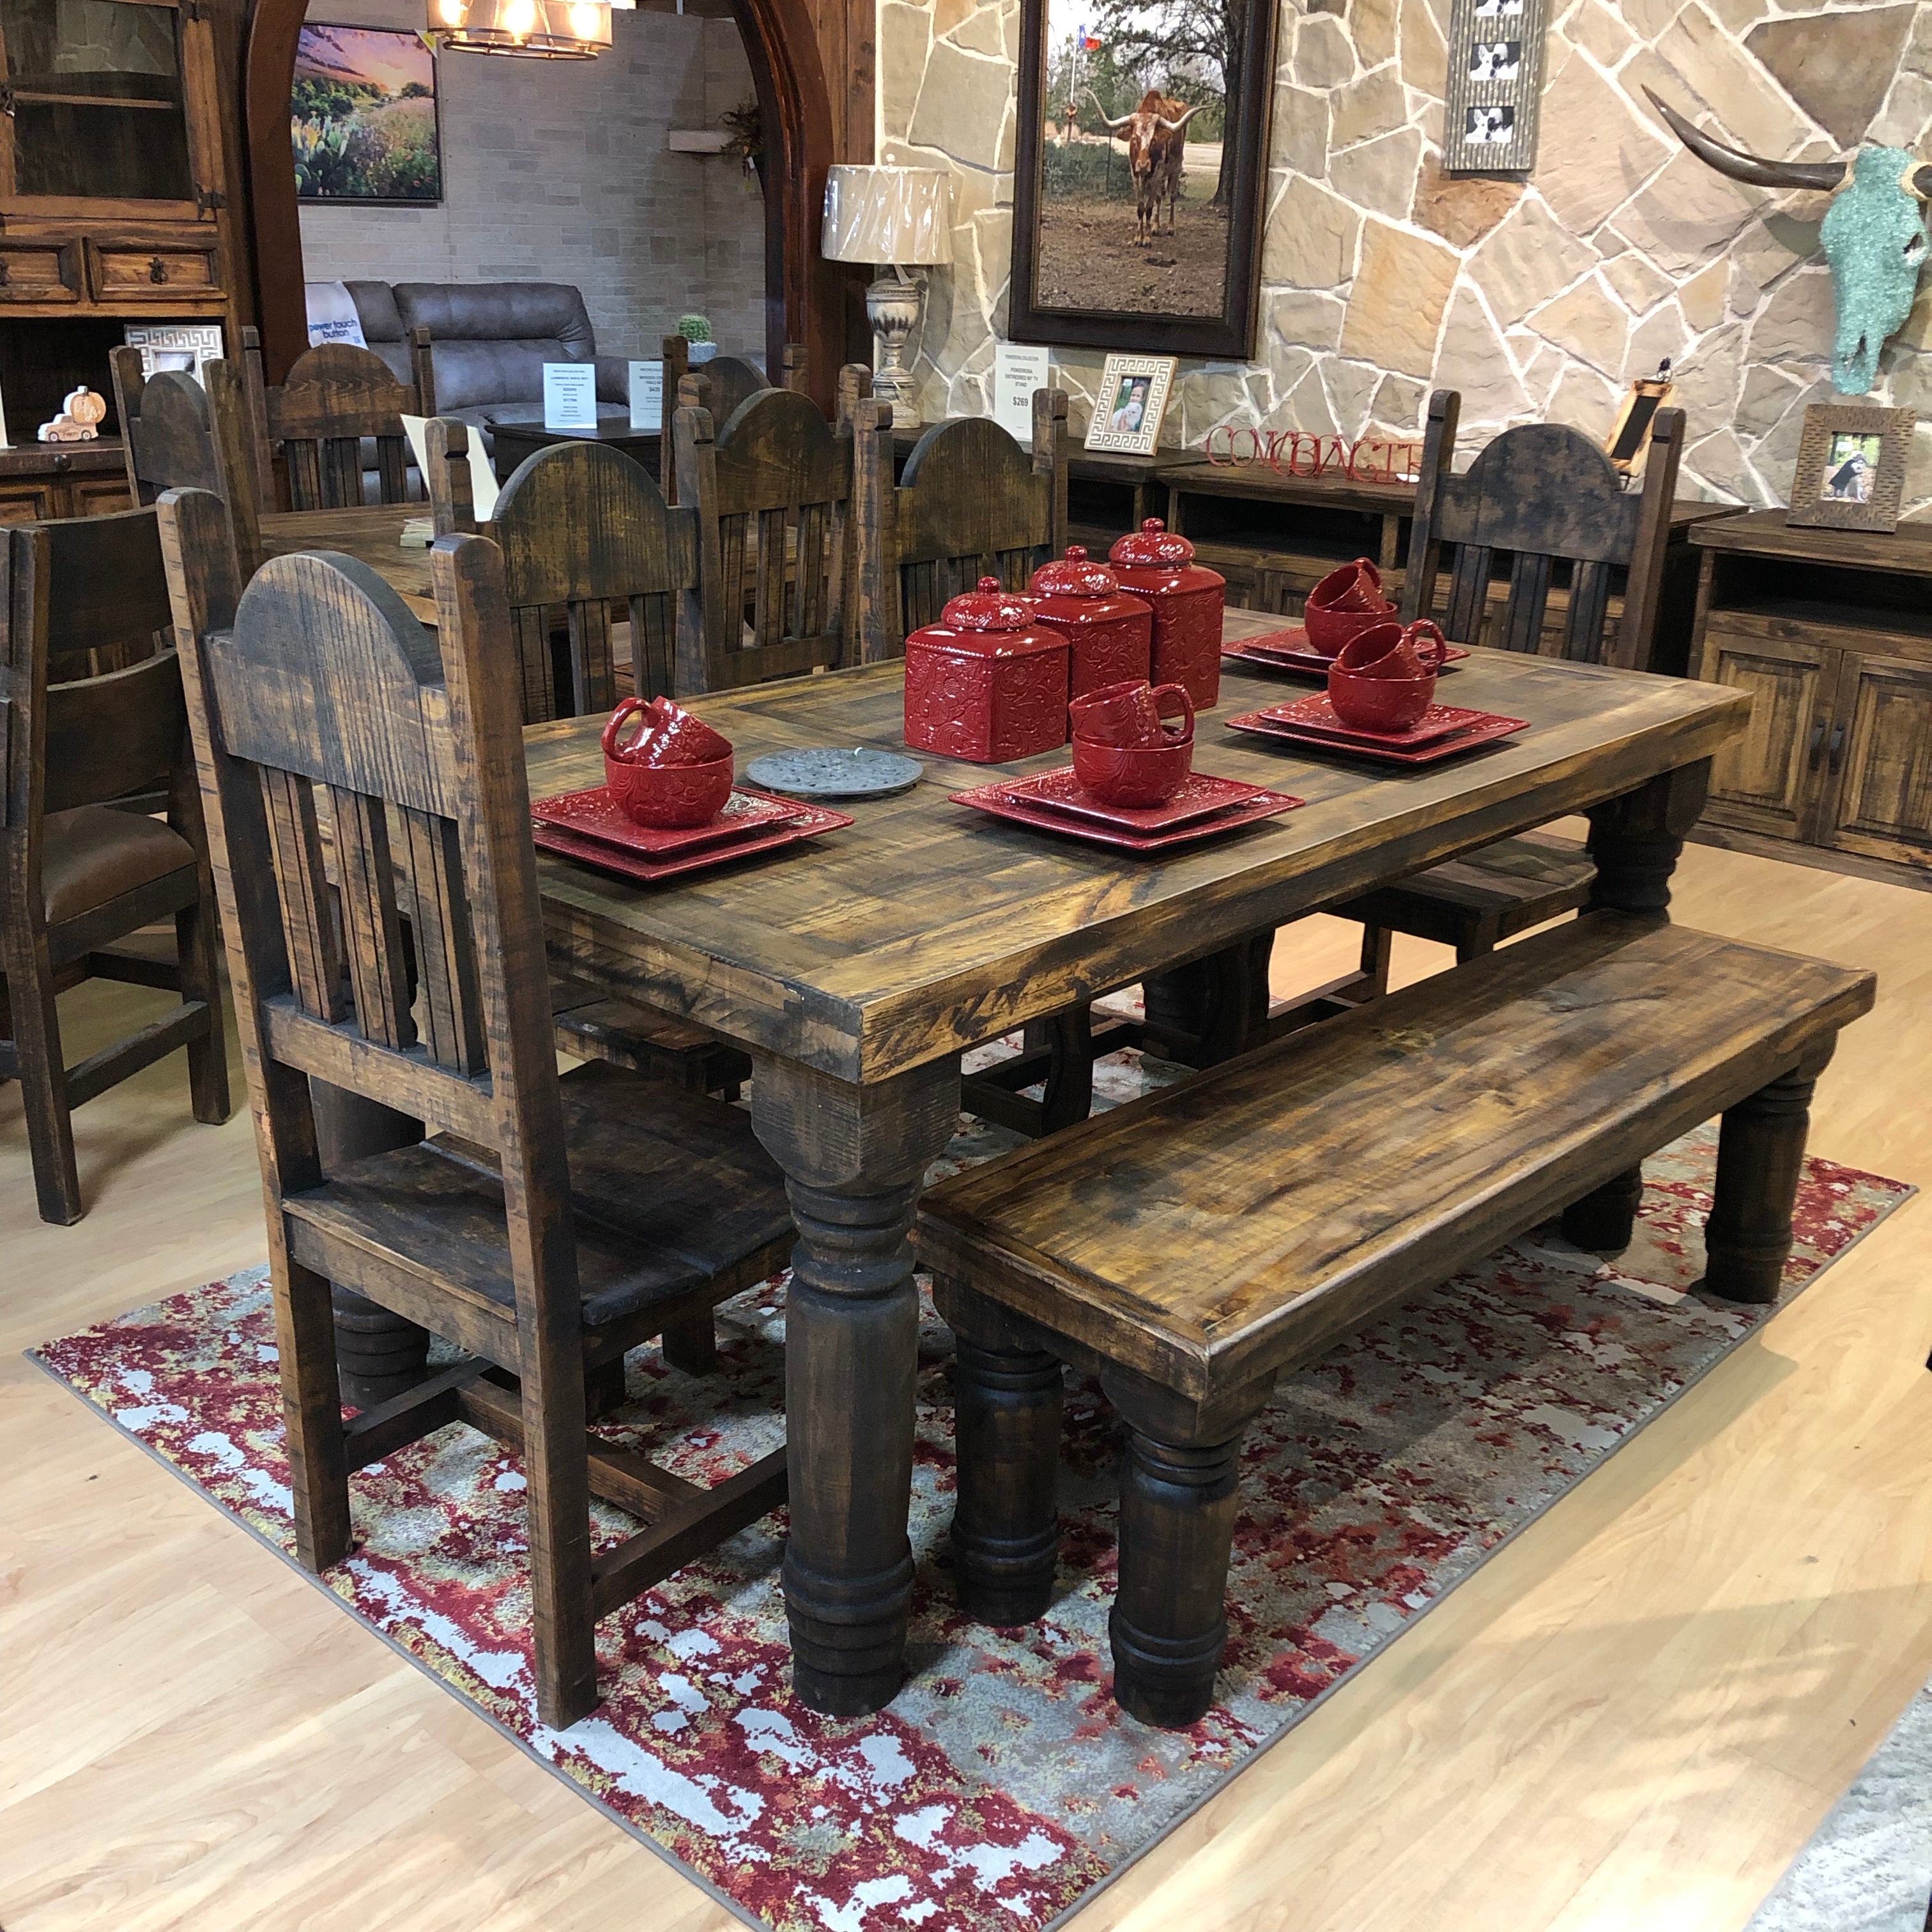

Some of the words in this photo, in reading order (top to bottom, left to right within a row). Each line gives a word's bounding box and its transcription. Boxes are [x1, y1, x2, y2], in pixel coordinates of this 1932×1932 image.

[309, 323, 332, 332] power
[333, 318, 358, 328] touch
[323, 330, 349, 338] button
[1013, 397, 1029, 406] $269
